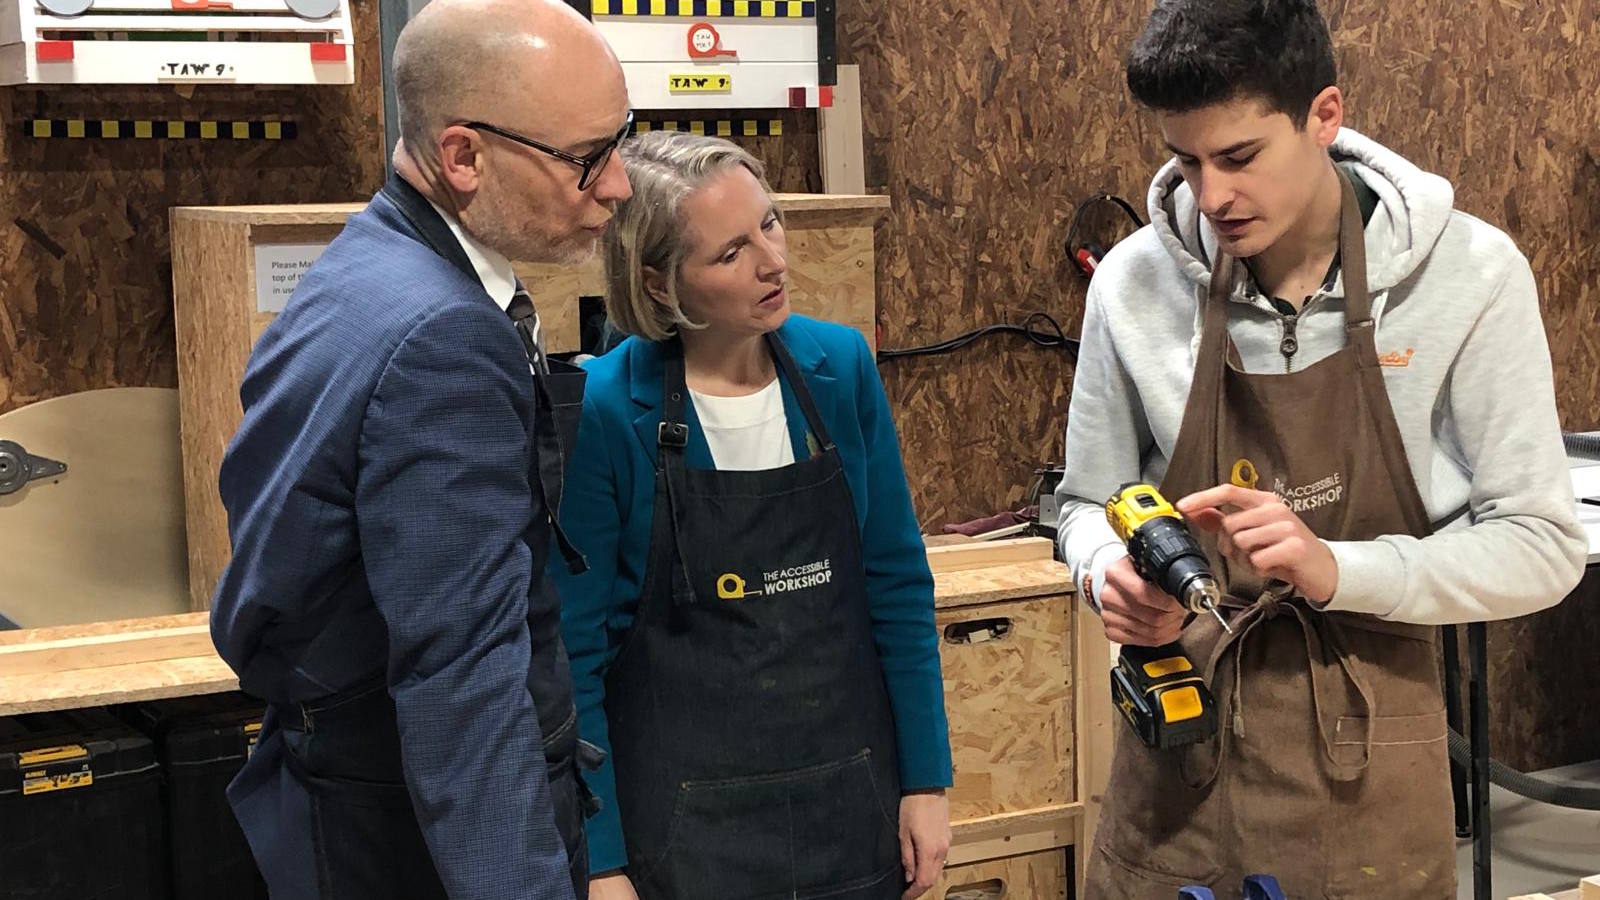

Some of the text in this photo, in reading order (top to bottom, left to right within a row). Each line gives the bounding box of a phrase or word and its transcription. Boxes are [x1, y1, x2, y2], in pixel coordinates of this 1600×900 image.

[166, 63, 225, 76] TAW 9
[672, 78, 726, 88] TAW 9
[271, 260, 314, 269] Please Ma
[272, 274, 286, 282] top
[287, 273, 296, 281] of
[273, 286, 280, 294] in
[1286, 472, 1341, 498] ACCESSIBLE
[763, 559, 830, 582] THE ACCESSIBLE
[764, 570, 832, 595] WORKSHOP
